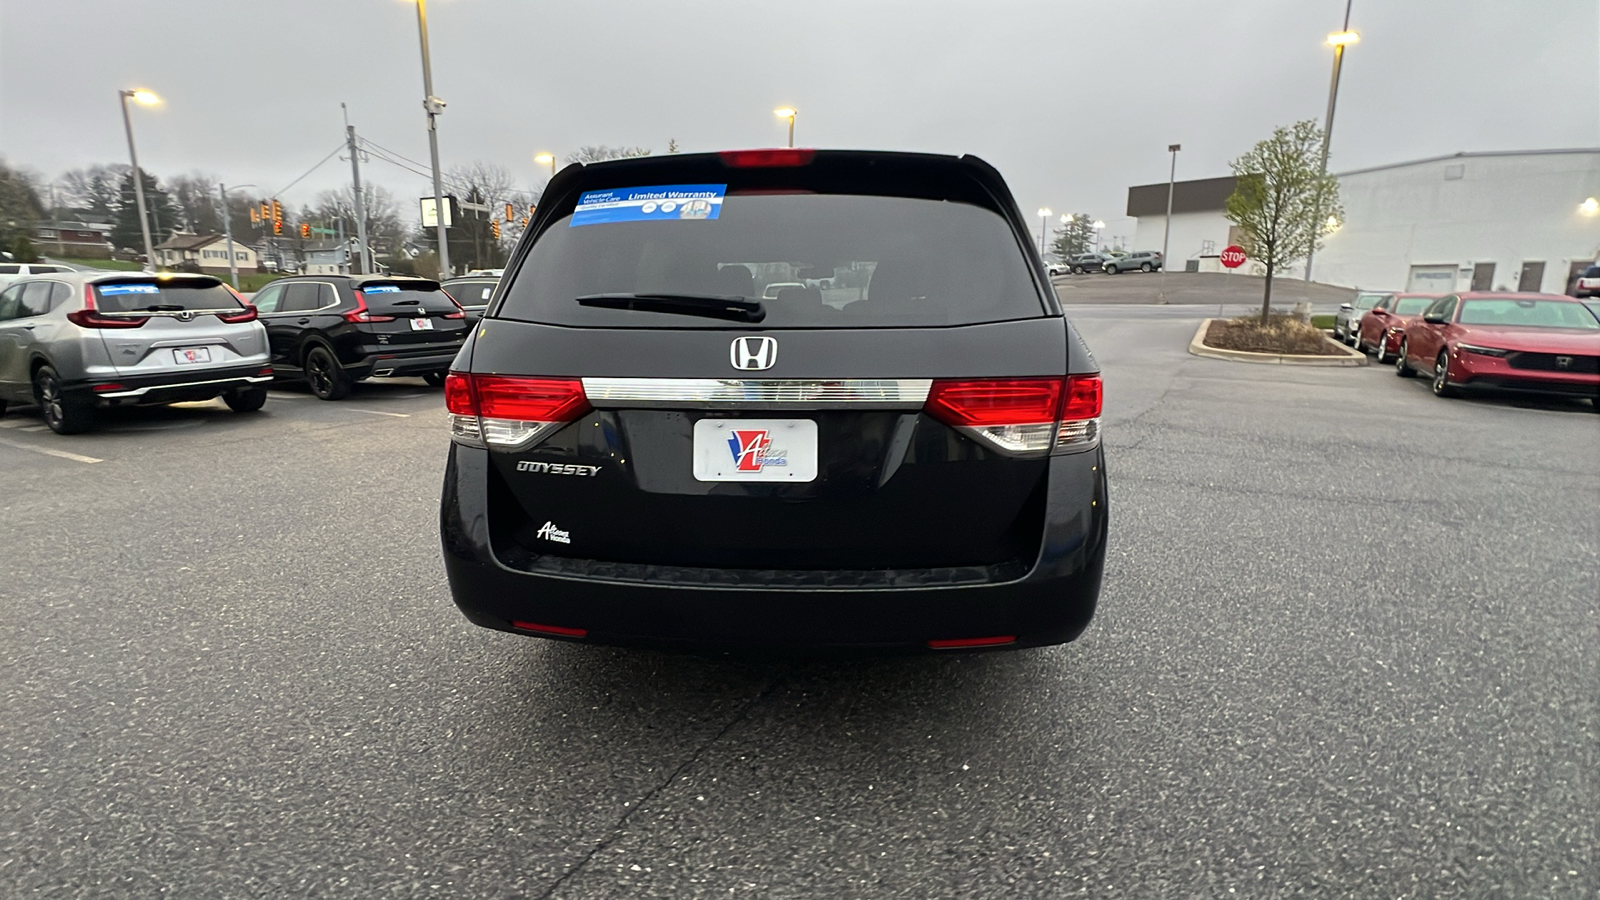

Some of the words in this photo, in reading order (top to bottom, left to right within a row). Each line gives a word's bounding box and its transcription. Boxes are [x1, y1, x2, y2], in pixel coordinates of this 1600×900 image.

[584, 192, 613, 200] Assurant
[628, 192, 667, 201] Limited
[668, 191, 717, 200] Warranty
[1221, 251, 1246, 263] STOP
[516, 460, 602, 476] ODYSSEY
